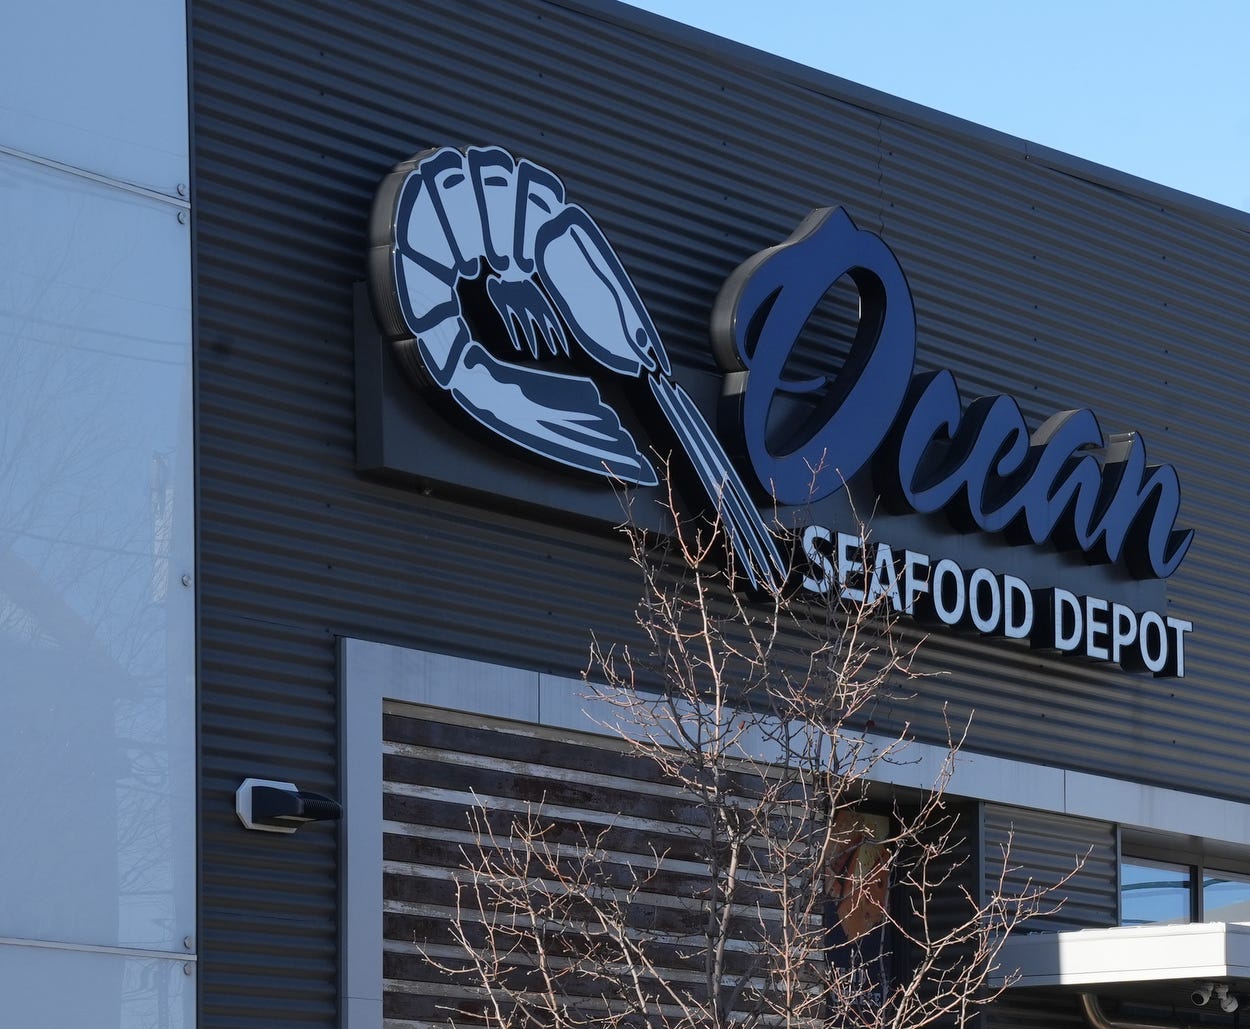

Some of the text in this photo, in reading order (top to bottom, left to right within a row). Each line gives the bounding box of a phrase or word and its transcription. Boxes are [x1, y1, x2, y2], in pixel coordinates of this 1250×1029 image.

[730, 205, 1195, 579] Ocean
[802, 525, 1194, 678] SEAFOOD DEPOT
